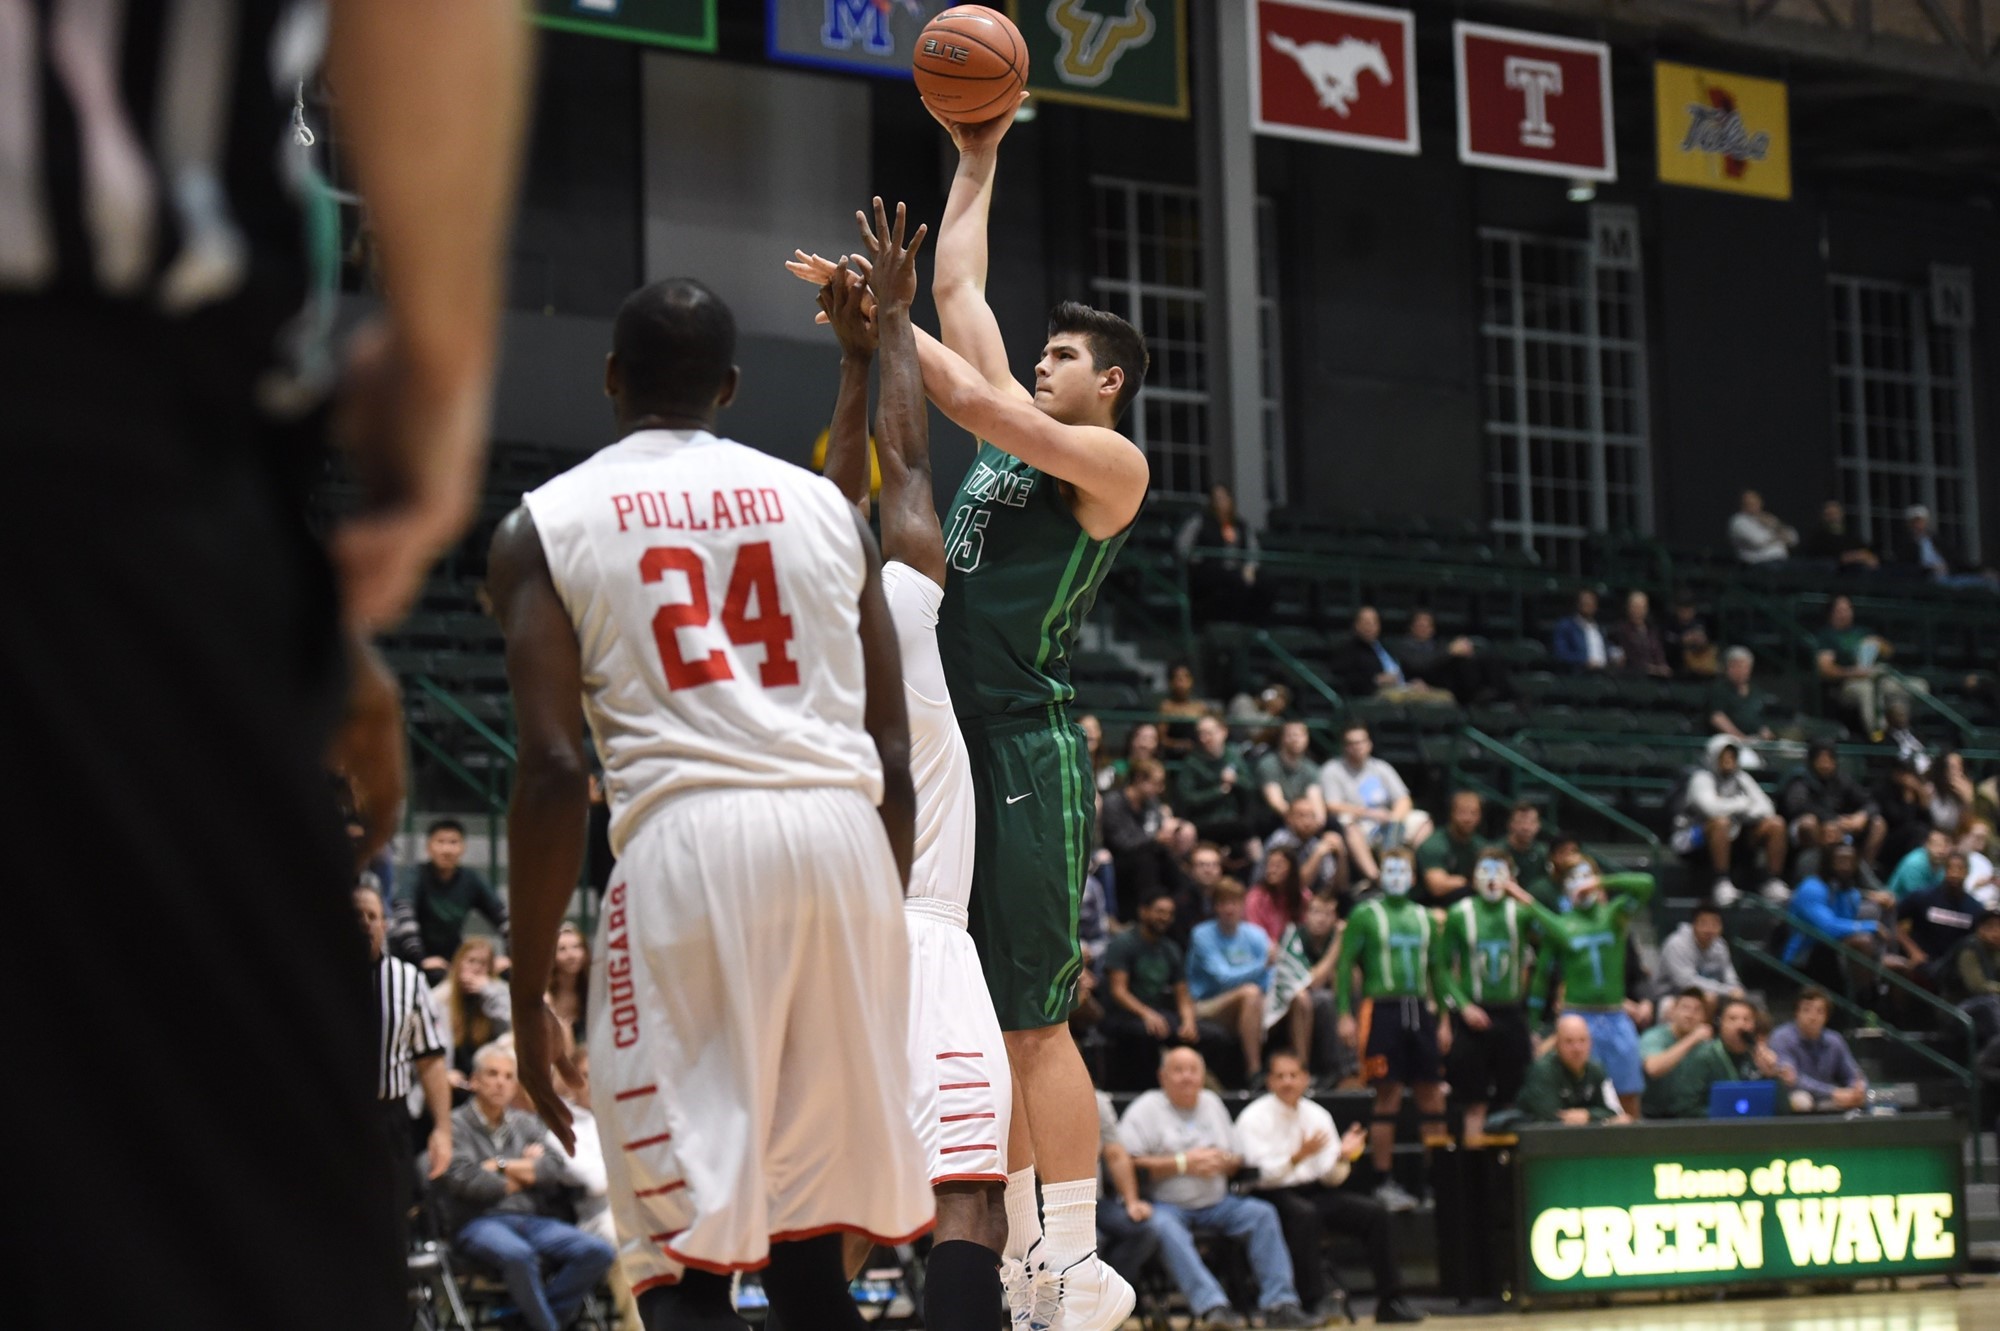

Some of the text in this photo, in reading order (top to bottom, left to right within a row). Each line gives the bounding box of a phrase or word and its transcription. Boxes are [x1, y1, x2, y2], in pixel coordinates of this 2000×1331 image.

[821, 0, 894, 56] M
[923, 39, 970, 64] ELITE
[1504, 55, 1563, 149] T
[611, 487, 785, 533] POLLARD
[944, 504, 991, 573] 15
[638, 540, 801, 692] 24
[609, 880, 640, 1049] COUGARS
[1653, 1157, 1842, 1200] Home of the
[1530, 1192, 1956, 1281] GREEN WAVE
